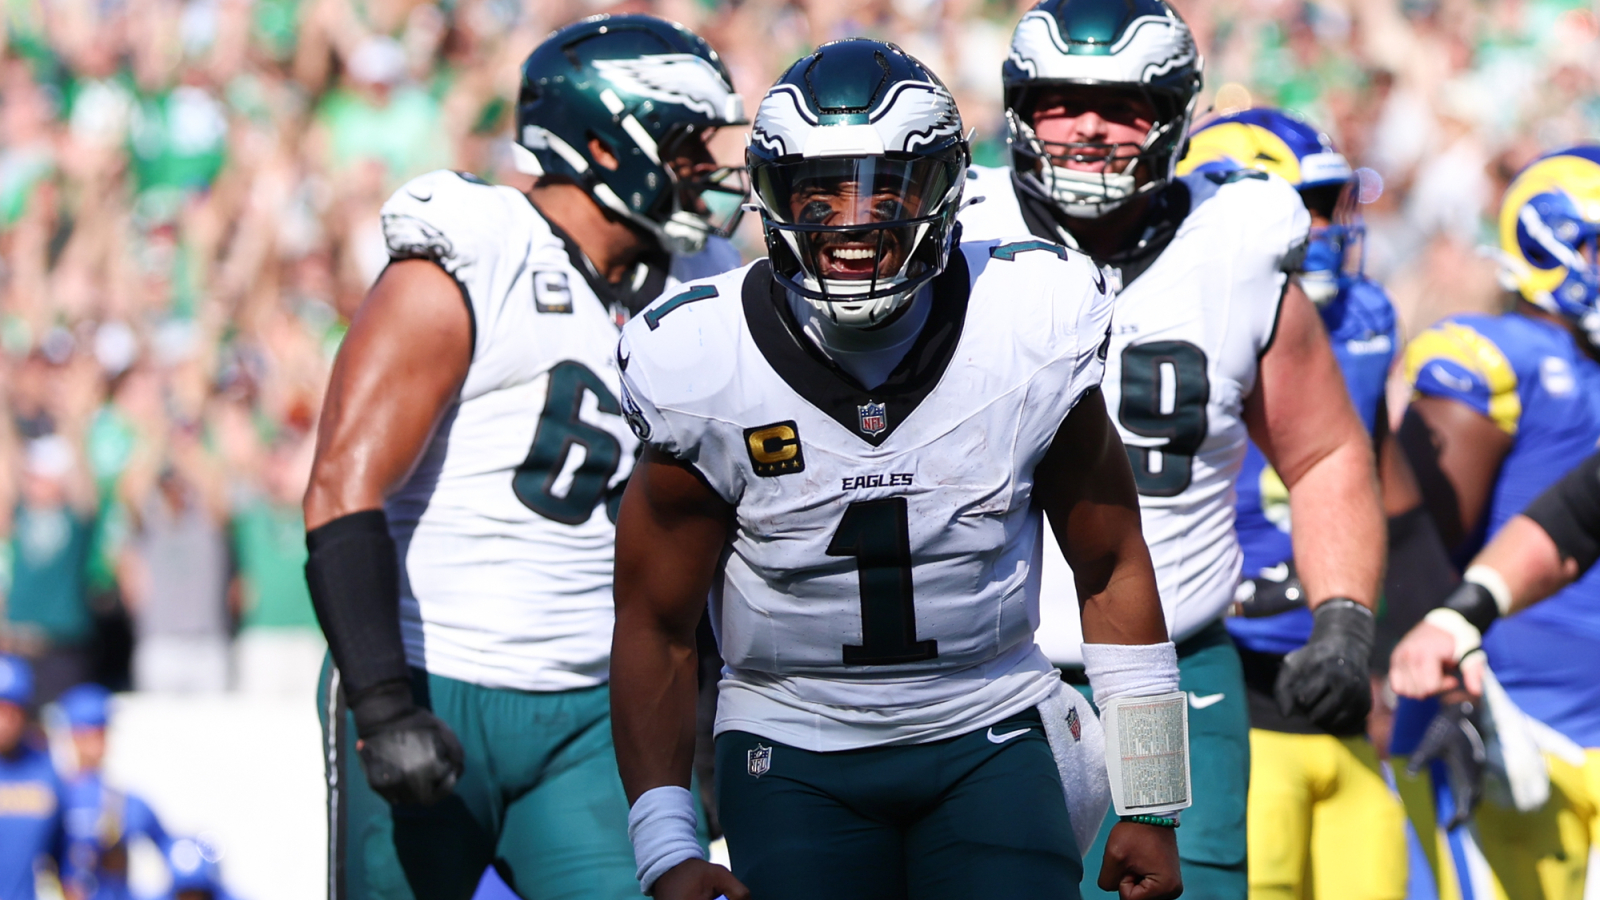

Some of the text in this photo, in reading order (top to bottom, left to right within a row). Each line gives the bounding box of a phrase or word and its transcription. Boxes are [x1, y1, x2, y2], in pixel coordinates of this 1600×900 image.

[989, 240, 1068, 262] 1
[534, 272, 572, 305] C
[643, 285, 719, 331] 1
[863, 415, 885, 431] NFL
[512, 359, 624, 526] 6
[749, 425, 798, 464] C
[842, 473, 914, 490] EAGLES
[826, 498, 938, 666] 1
